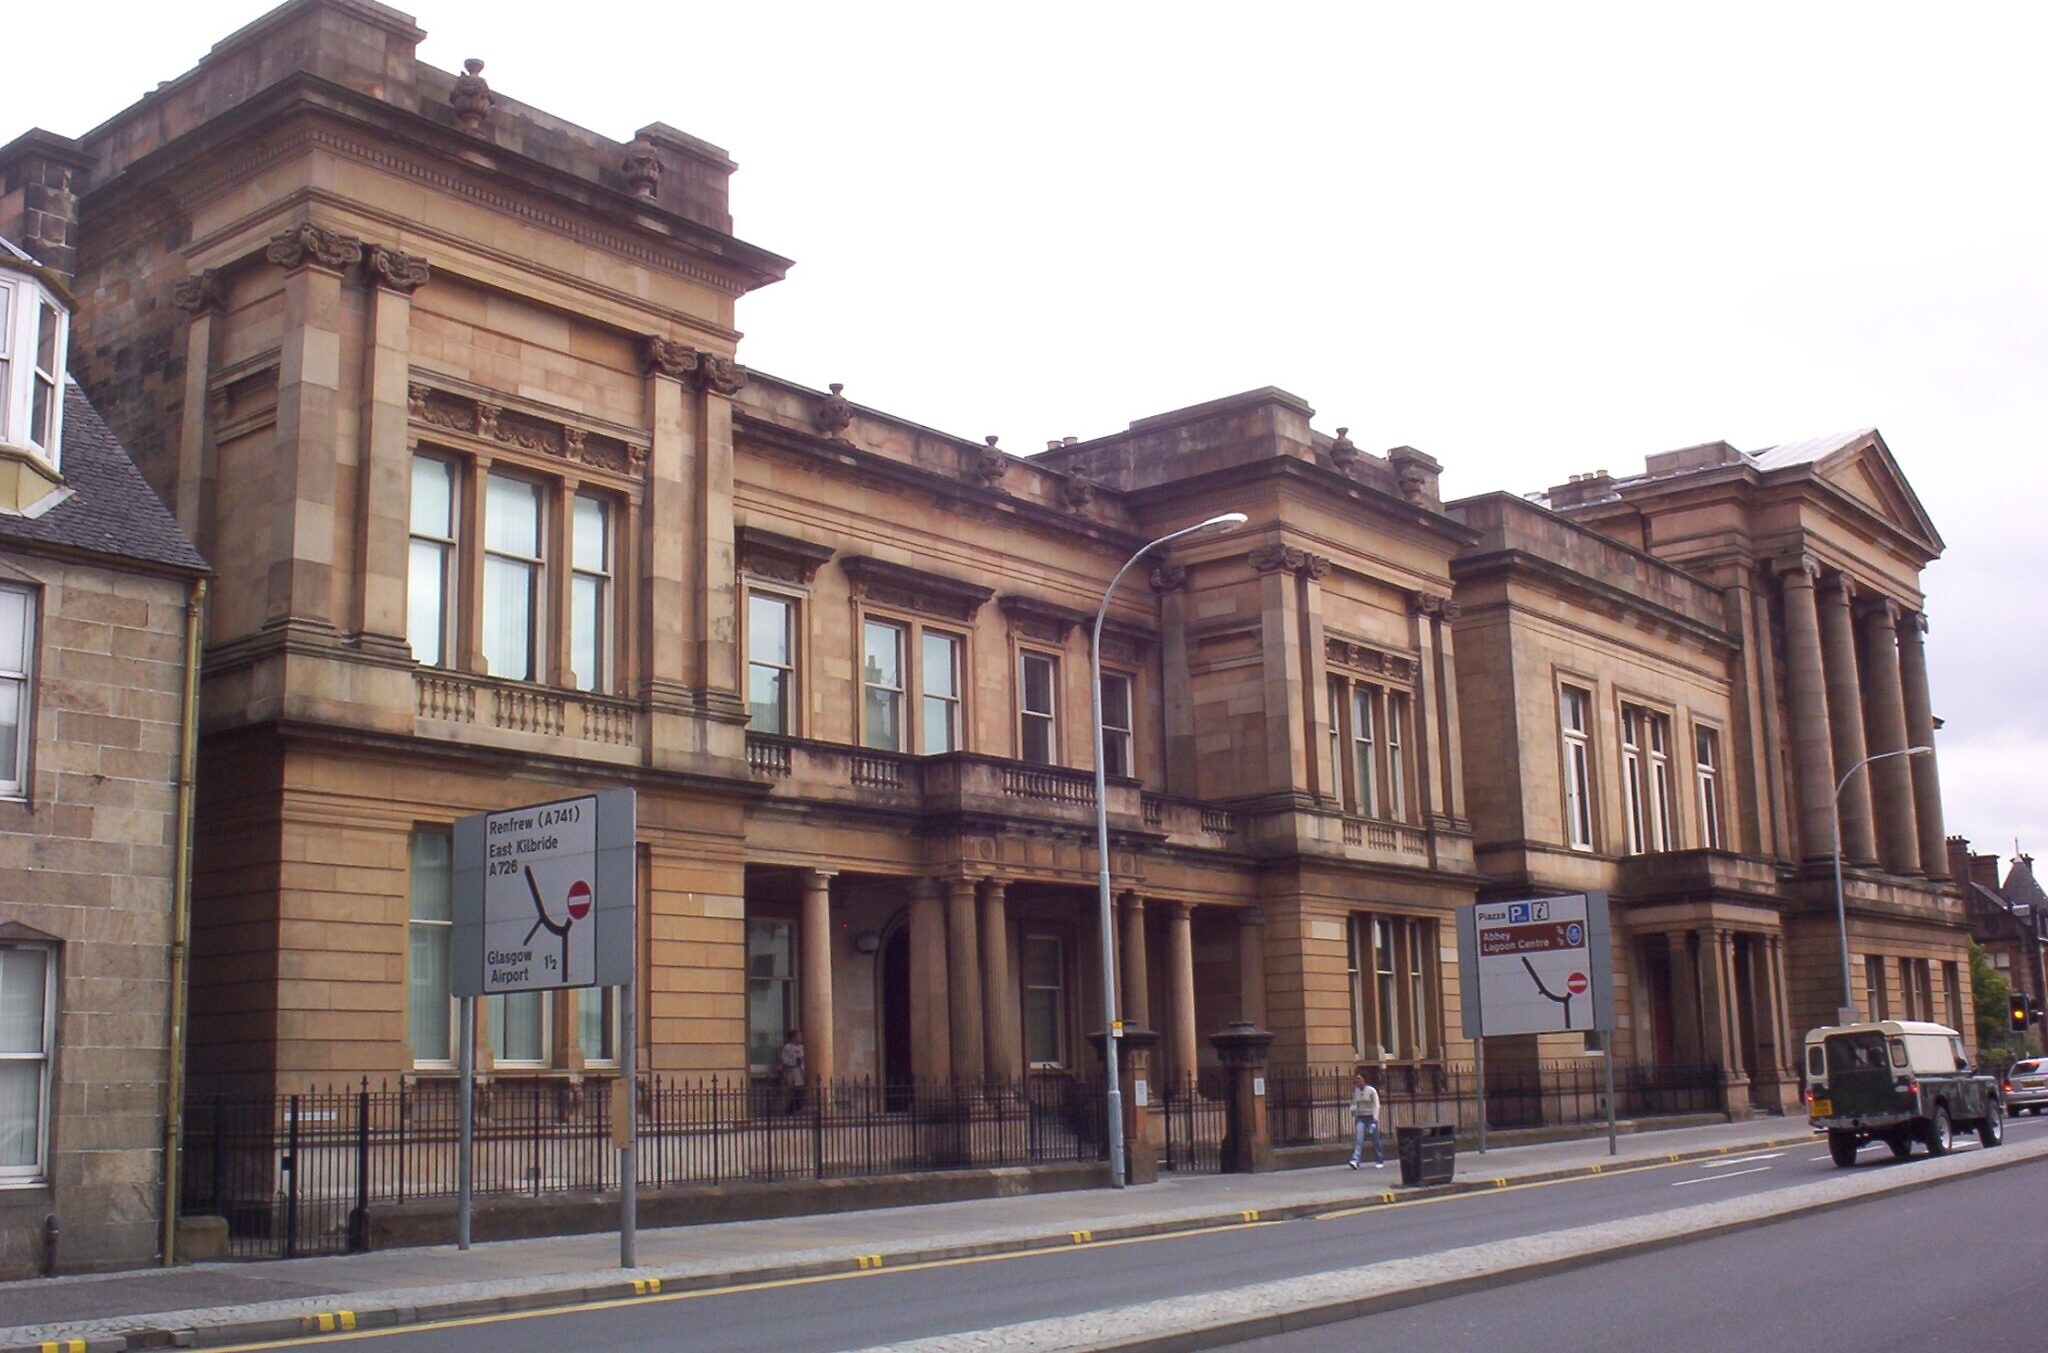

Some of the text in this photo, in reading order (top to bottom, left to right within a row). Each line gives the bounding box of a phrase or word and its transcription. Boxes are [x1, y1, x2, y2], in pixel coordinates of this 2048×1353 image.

[489, 805, 580, 836] Renfrew (A741)
[489, 835, 558, 858] East Kilbride
[489, 859, 518, 877] A726
[1479, 912, 1506, 920] Piazza
[1511, 906, 1522, 922] P
[1484, 932, 1511, 941] Abbey
[1484, 939, 1550, 952] Lagoon Centre
[487, 949, 533, 968] Glasgow
[490, 967, 530, 984] Airport
